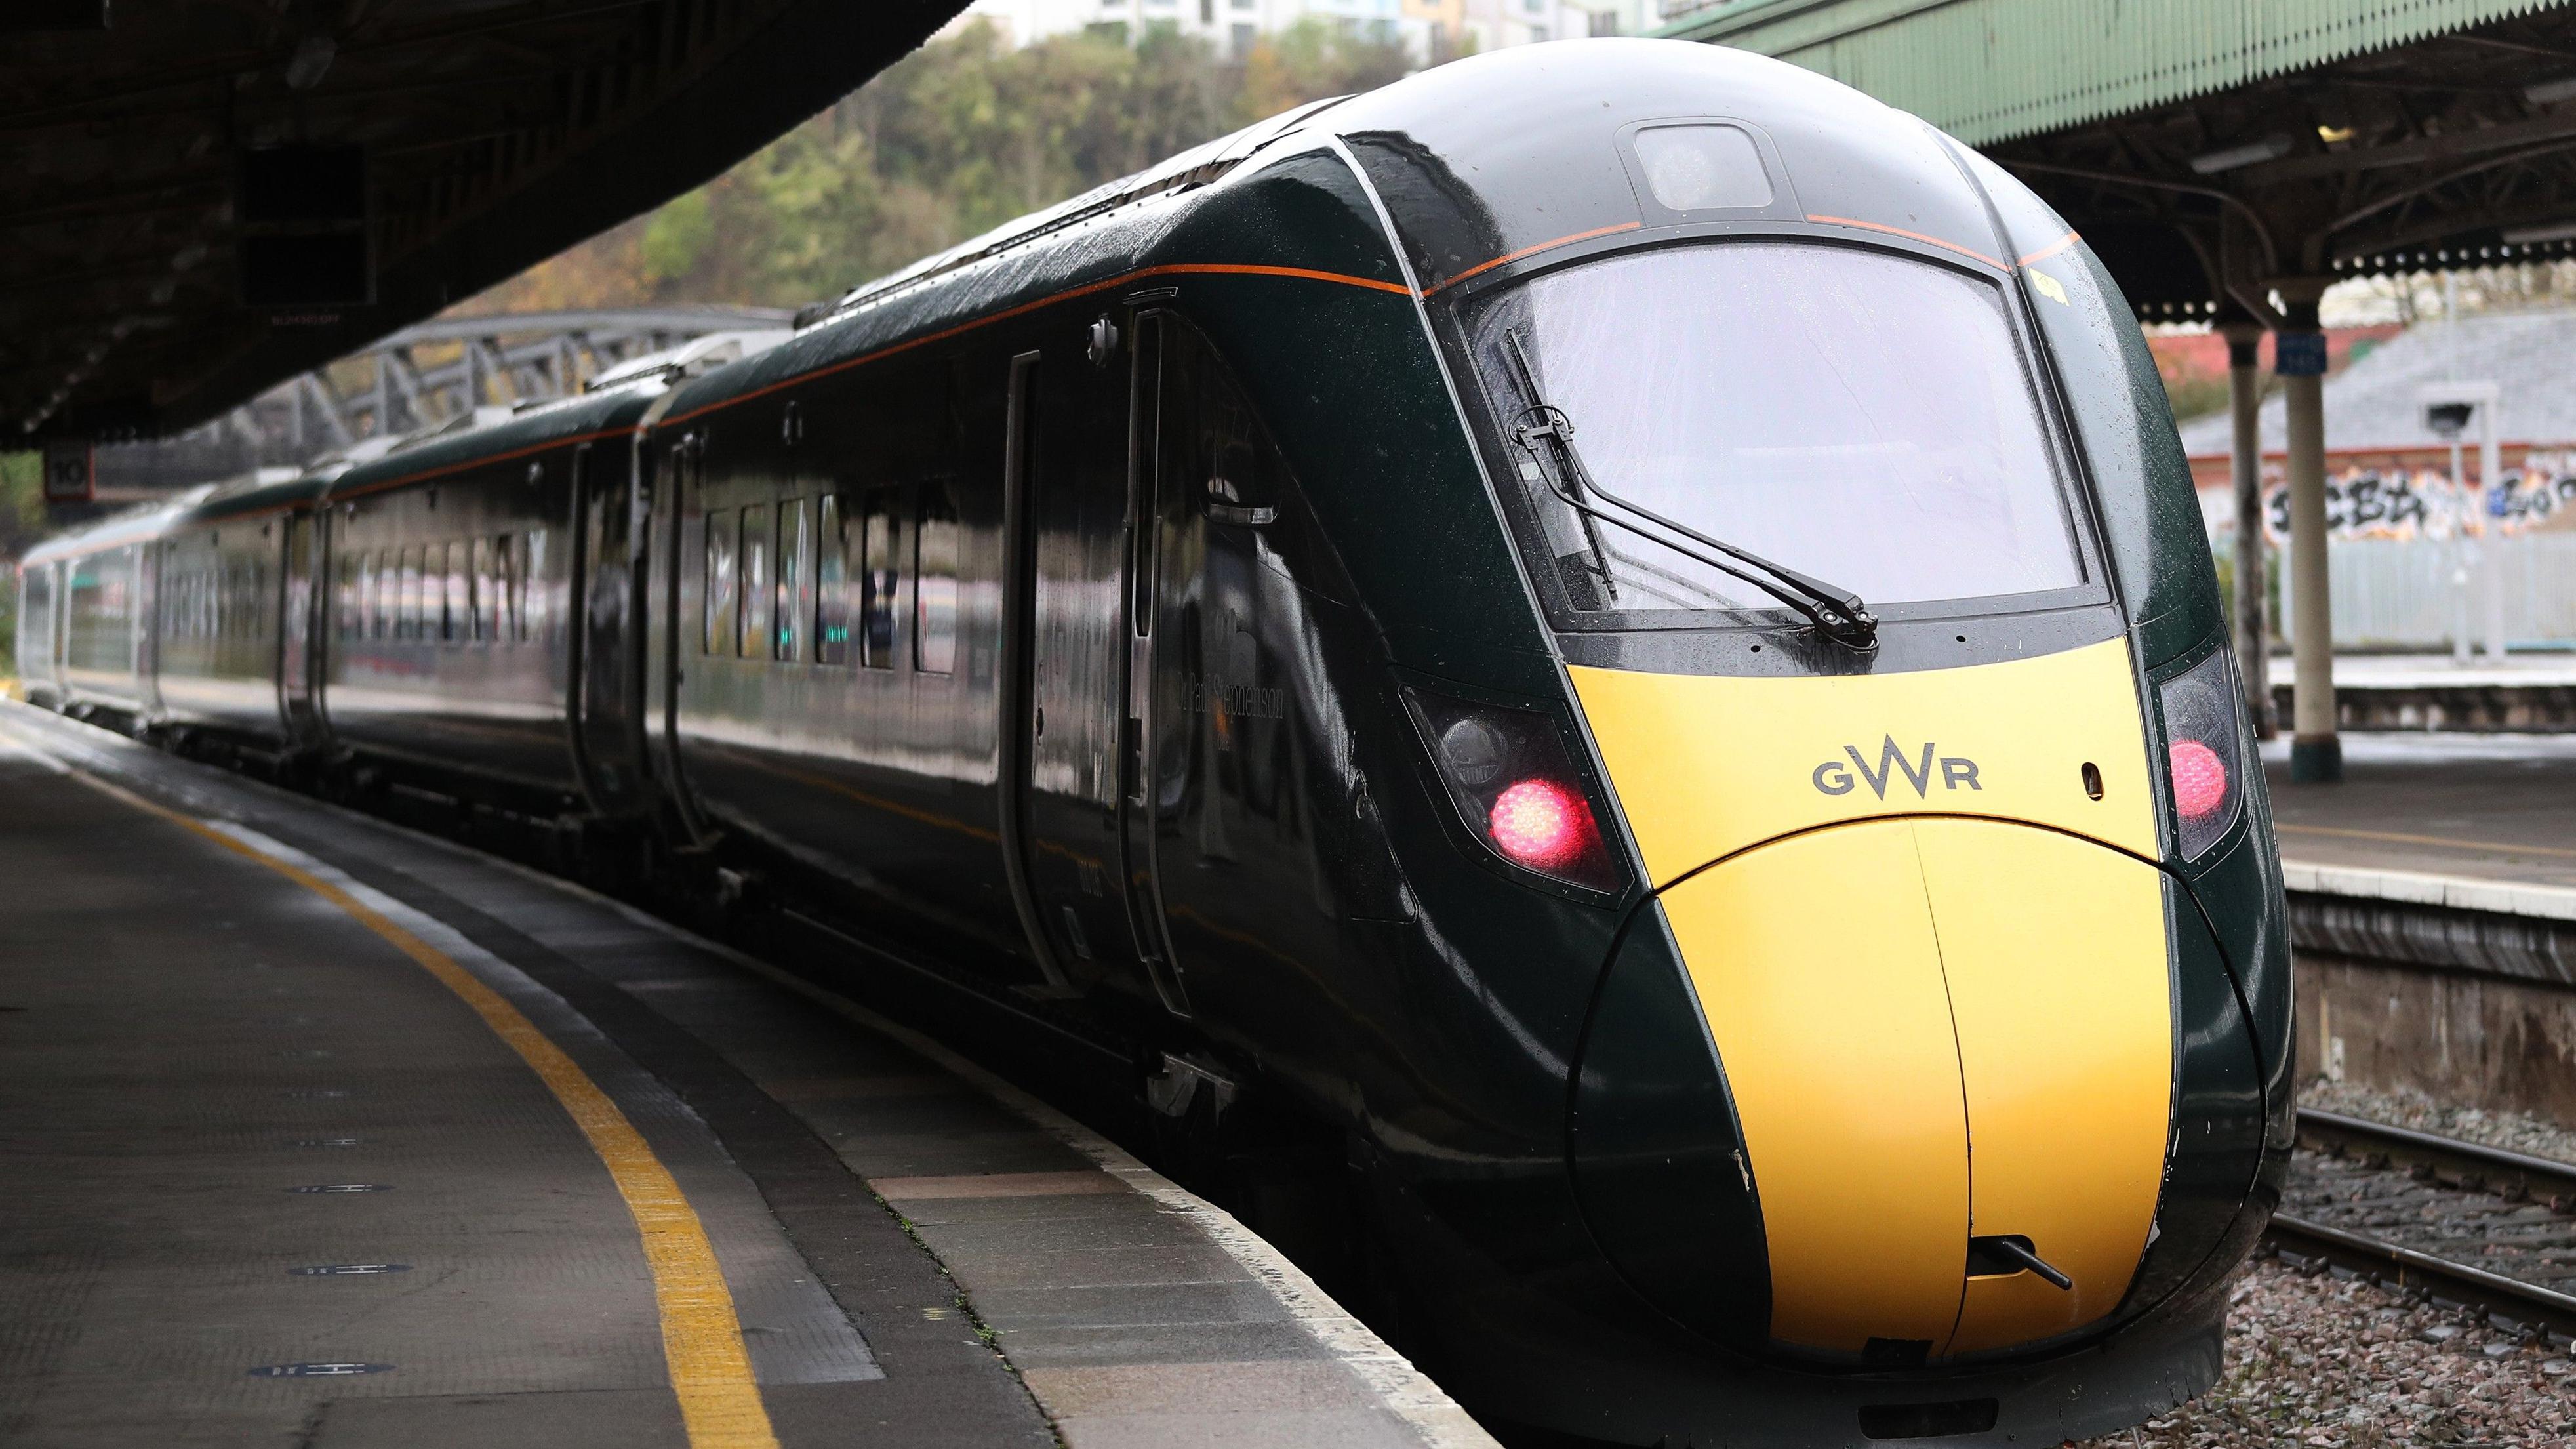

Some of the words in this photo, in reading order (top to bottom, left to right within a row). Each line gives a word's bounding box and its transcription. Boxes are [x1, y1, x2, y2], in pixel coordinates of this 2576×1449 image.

[54, 461, 85, 483] 10
[1213, 673, 1283, 724] Stephenson
[1812, 733, 1982, 801] GWR
